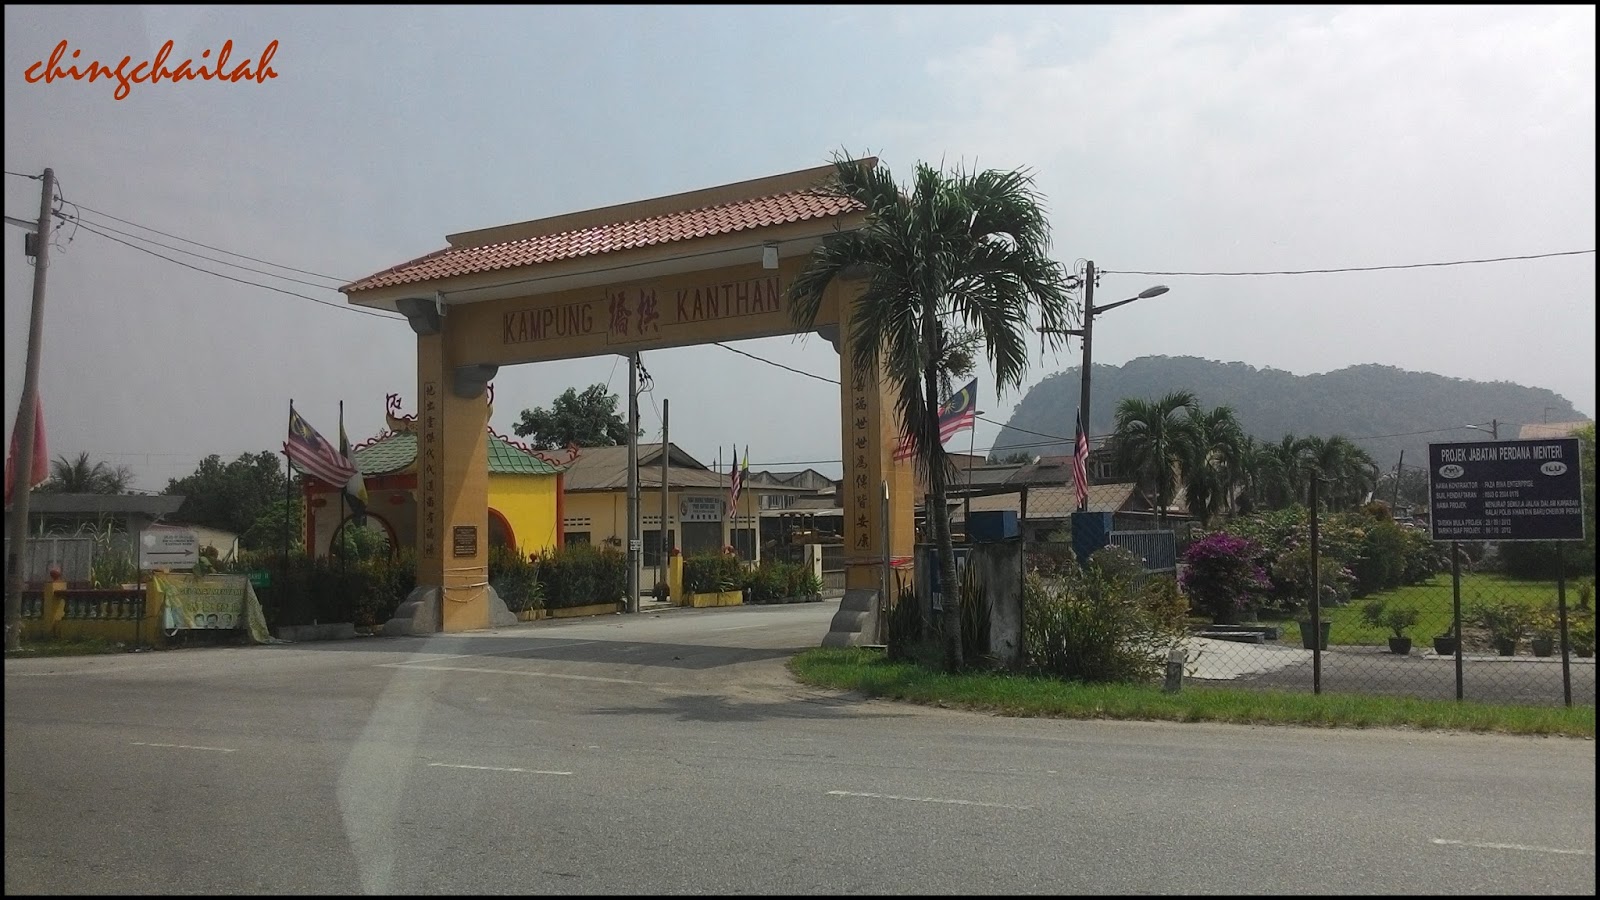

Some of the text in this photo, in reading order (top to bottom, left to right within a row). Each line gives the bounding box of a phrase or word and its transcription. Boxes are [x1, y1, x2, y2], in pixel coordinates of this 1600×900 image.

[504, 303, 593, 343] KAMPUNG
[676, 277, 781, 322] KANTHAN
[1441, 445, 1563, 462] PROJEK JABATAN PERDANA MENTERI
